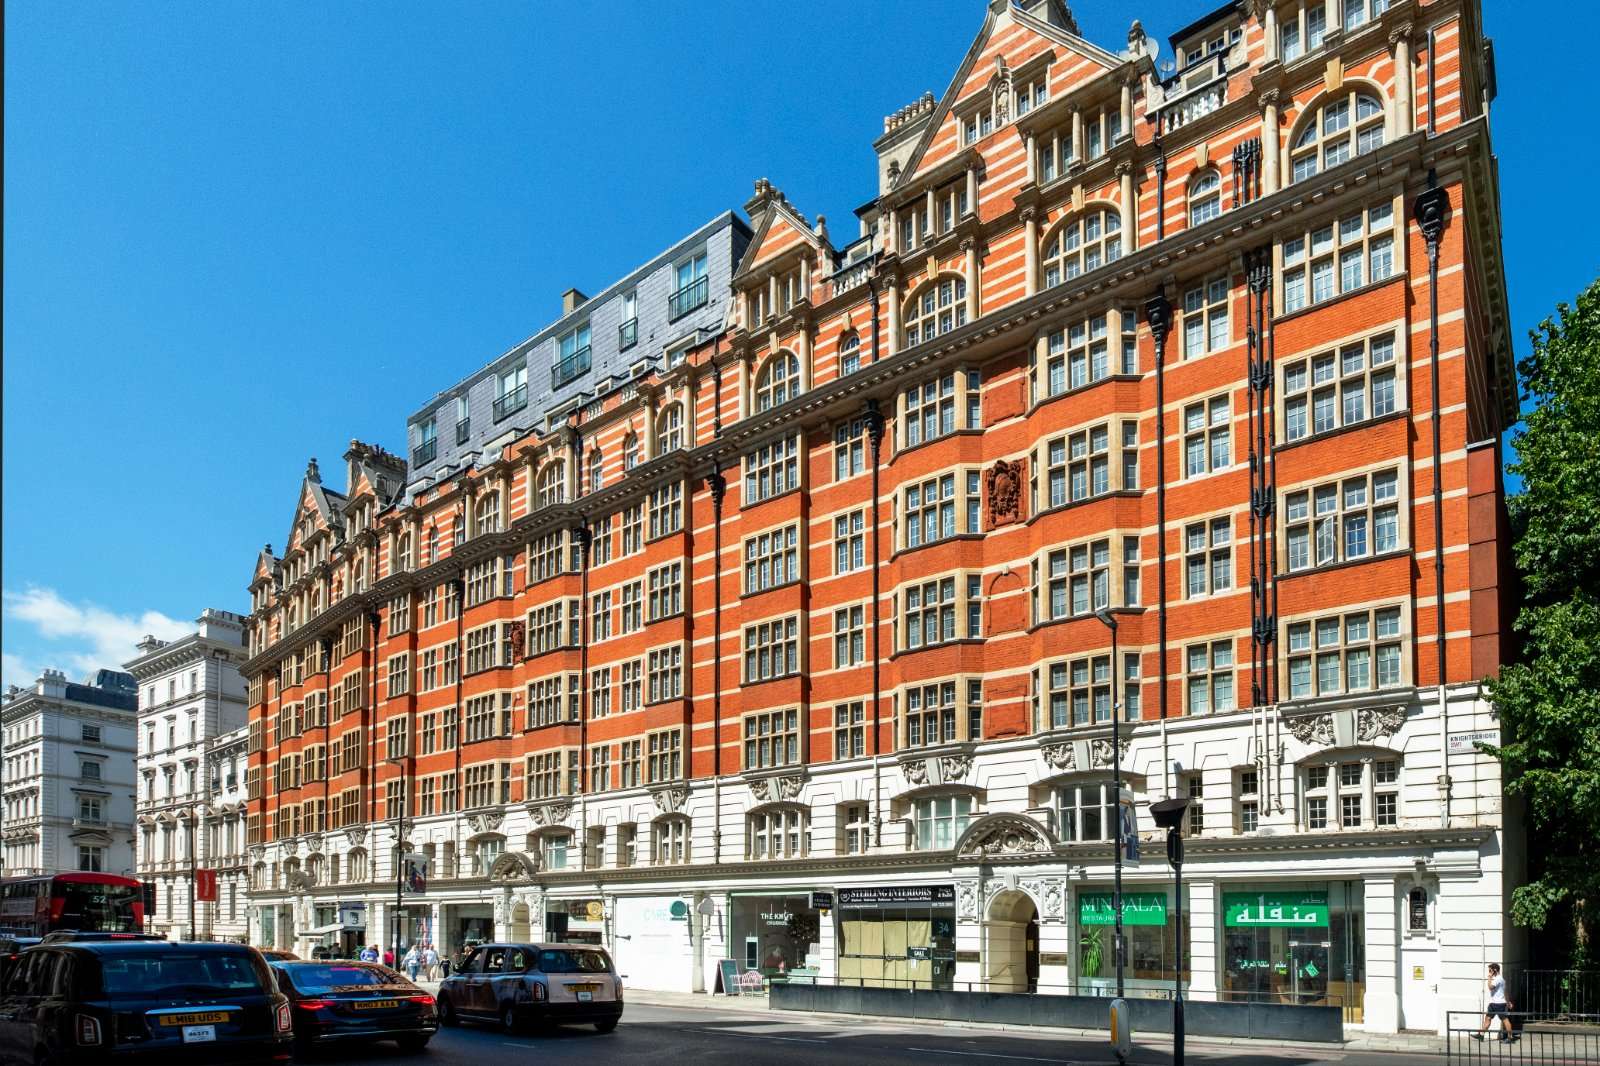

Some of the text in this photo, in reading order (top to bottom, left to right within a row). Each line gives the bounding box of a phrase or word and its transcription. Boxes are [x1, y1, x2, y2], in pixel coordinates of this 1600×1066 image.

[1450, 732, 1497, 742] KNIGHTSBRIDGE
[850, 888, 888, 898] STERLING
[888, 887, 932, 897] INTERIORS
[93, 896, 107, 904] 52
[1081, 897, 1162, 912] MINALA
[1236, 894, 1317, 923] منقلة
